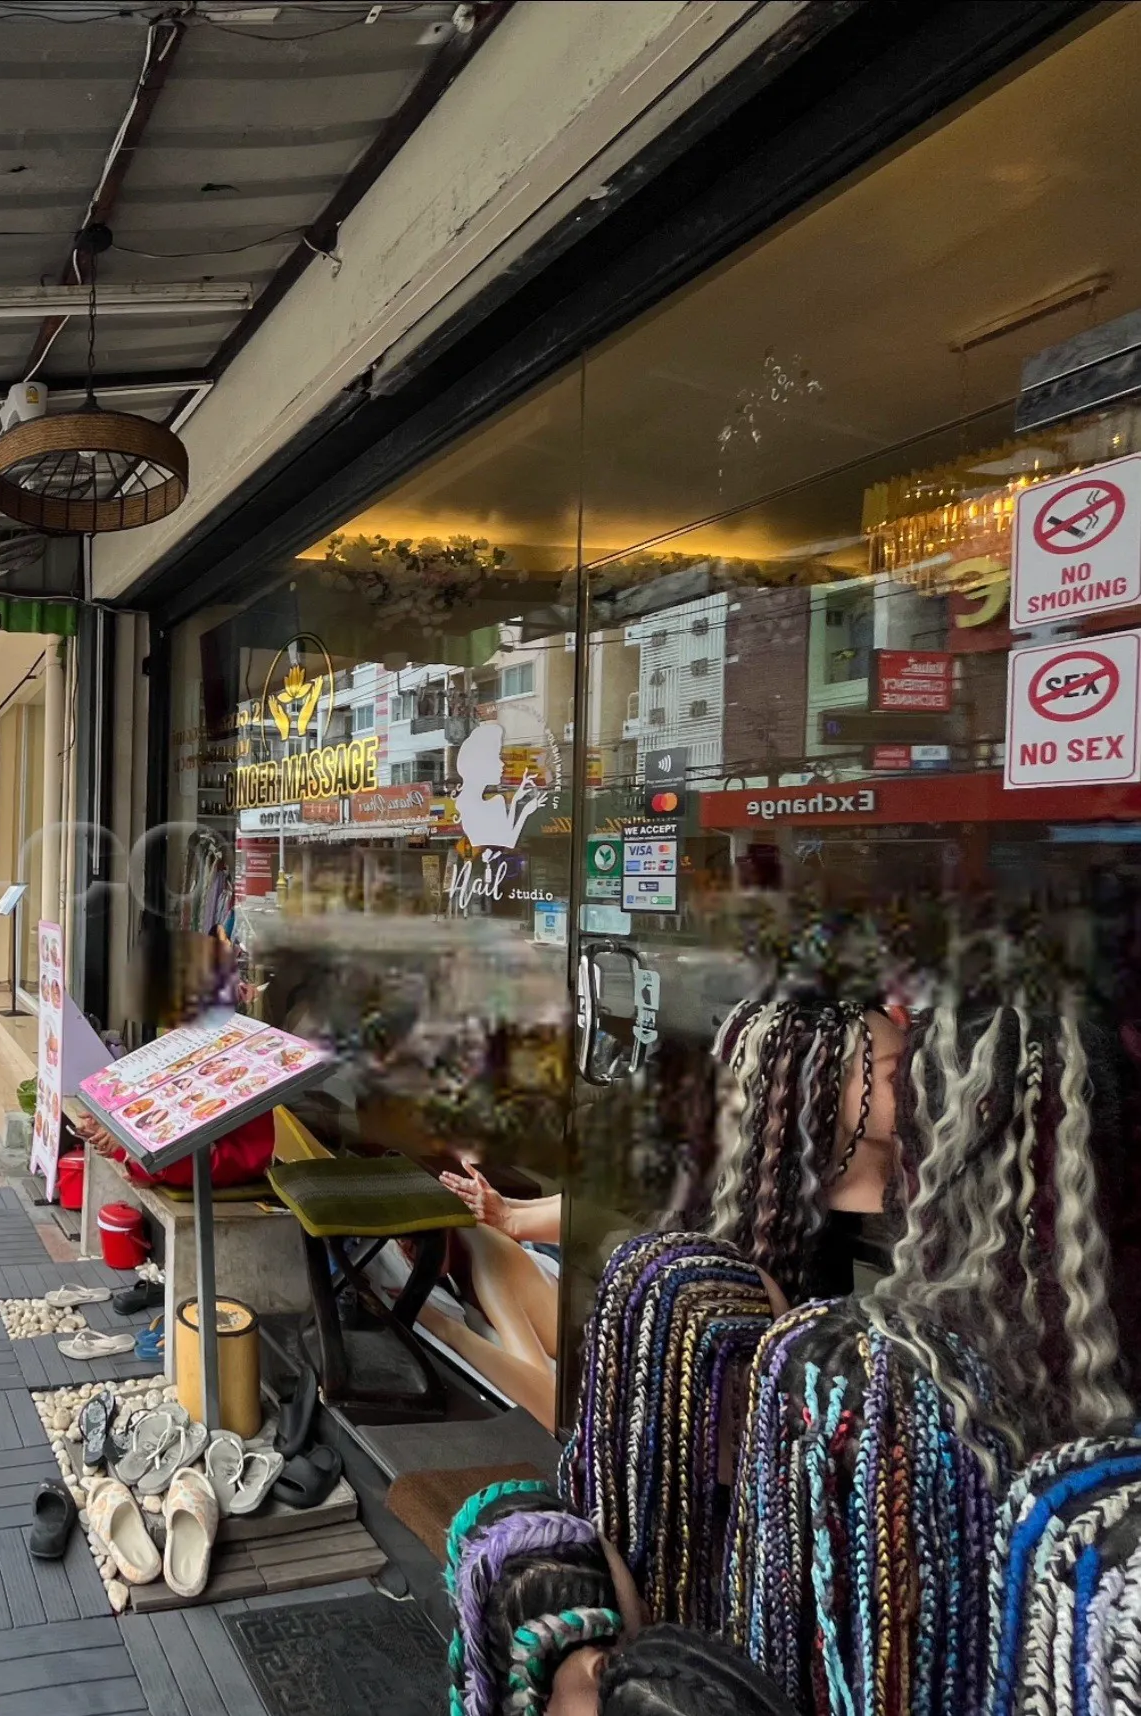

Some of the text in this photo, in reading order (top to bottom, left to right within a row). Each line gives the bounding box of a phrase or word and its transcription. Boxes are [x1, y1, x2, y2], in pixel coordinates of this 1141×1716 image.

[1061, 562, 1091, 586] NO
[1027, 577, 1127, 614] SMOKING
[1045, 673, 1100, 698] SEX
[1020, 734, 1125, 766] NO SEX
[225, 760, 278, 812] GINGER
[281, 736, 379, 803] MASSAGE
[624, 824, 677, 836] WE ACCEPT
[628, 845, 653, 856] VISA
[443, 860, 508, 909] Nail
